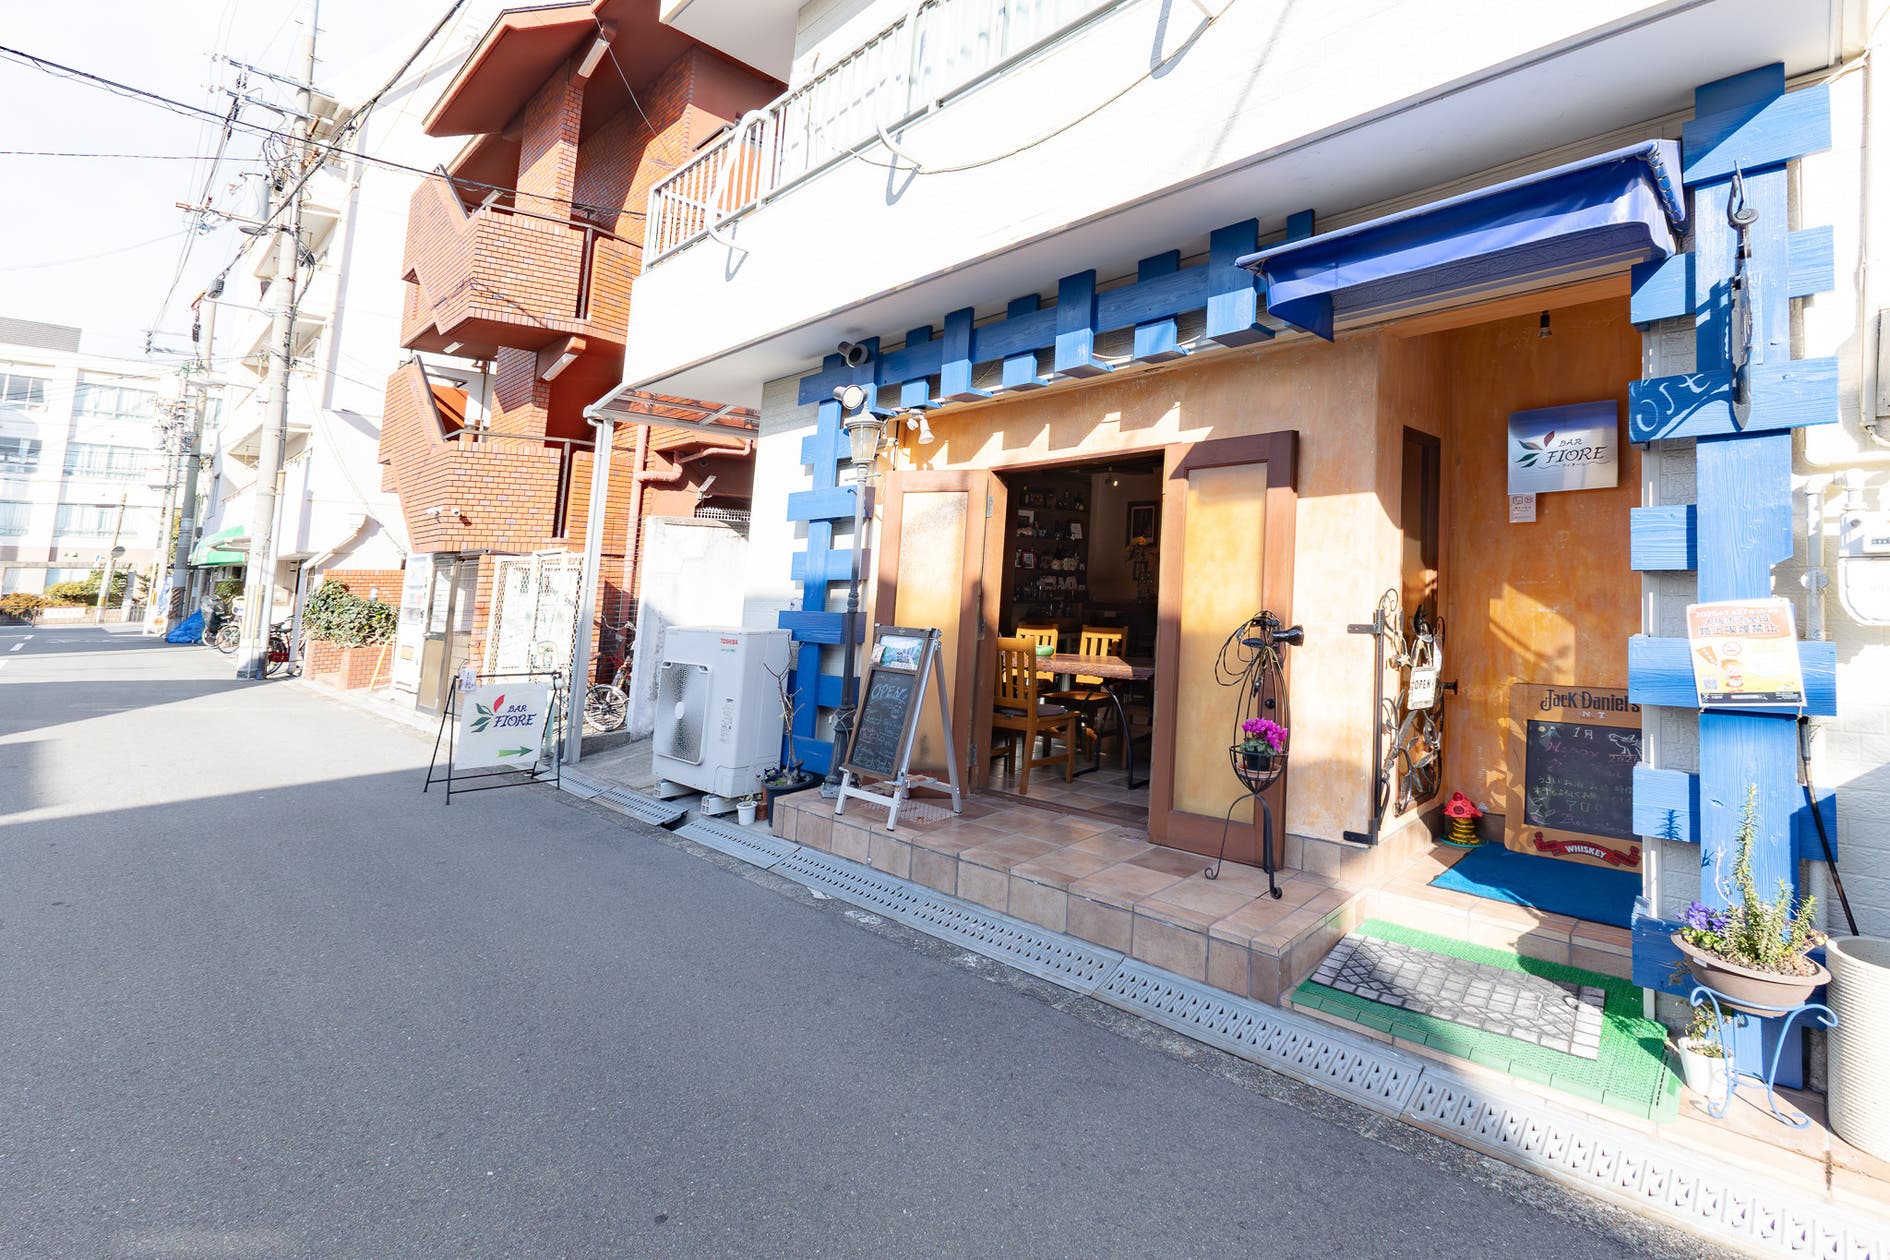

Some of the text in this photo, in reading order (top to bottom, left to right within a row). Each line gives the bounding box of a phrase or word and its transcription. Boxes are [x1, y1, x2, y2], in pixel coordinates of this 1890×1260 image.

[1559, 438, 1582, 447] BAR
[1546, 446, 1608, 464] FIORE
[1414, 679, 1432, 690] OPEN
[1540, 689, 1640, 713] Jack Daniels
[507, 704, 528, 713] BAR
[493, 713, 537, 728] FIORE
[1564, 845, 1607, 858] WHISKEY
